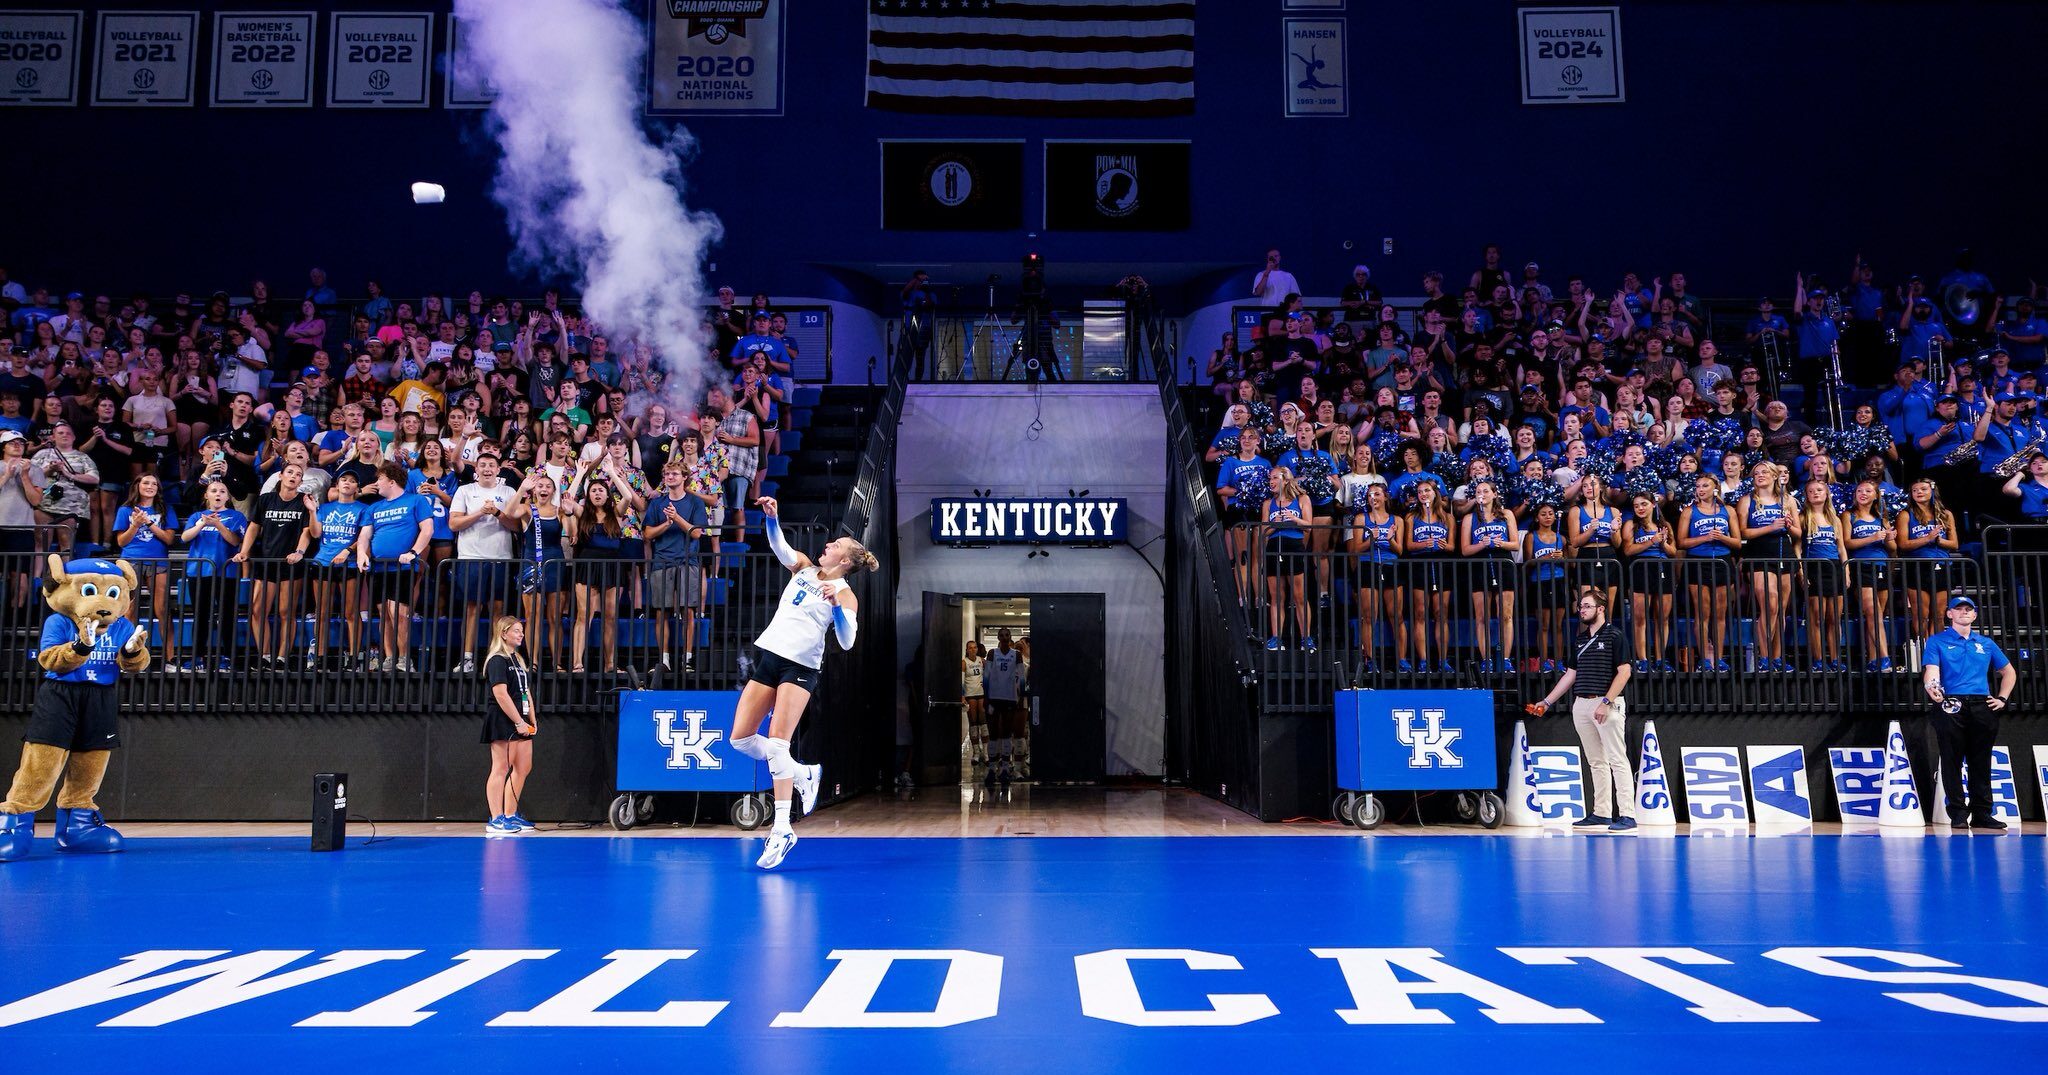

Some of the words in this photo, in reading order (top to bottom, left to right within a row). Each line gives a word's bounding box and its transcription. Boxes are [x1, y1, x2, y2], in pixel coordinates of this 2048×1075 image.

[674, 0, 763, 12] CHAMPIONSHIP
[0, 31, 67, 40] OLLEYBALL
[237, 22, 293, 31] WOMEN'S
[1293, 30, 1336, 39] HANSEN
[1533, 28, 1606, 38] VOLLEYBALL
[111, 32, 183, 41] VOLLEYBALL
[227, 33, 302, 42] BASKETBALL
[345, 33, 417, 42] VOLLEYBALL
[0, 43, 62, 61] 2020
[115, 44, 176, 62] 2021
[231, 45, 296, 63] 2022
[348, 45, 412, 63] 2022
[1539, 41, 1603, 59] 2024
[677, 56, 754, 77] 2020
[683, 80, 748, 90] NATIONAL
[677, 91, 753, 100] CHAMPIONS
[804, 315, 818, 324] 10
[1244, 315, 1255, 324] 11
[265, 510, 303, 520] KENTUCKY
[373, 506, 408, 519] KENTUCKY
[940, 502, 1119, 537] KENTUCKY
[792, 589, 807, 606] 8
[653, 709, 723, 770] UK
[1392, 708, 1463, 769] UK
[1640, 732, 1669, 810] CATS
[1888, 732, 1919, 811] CATS
[1530, 750, 1585, 819] CATS
[1682, 751, 1746, 820] CATS
[1751, 748, 1811, 820] A
[1830, 750, 1886, 818] ARE
[0, 948, 2048, 1028] WILDCATS
